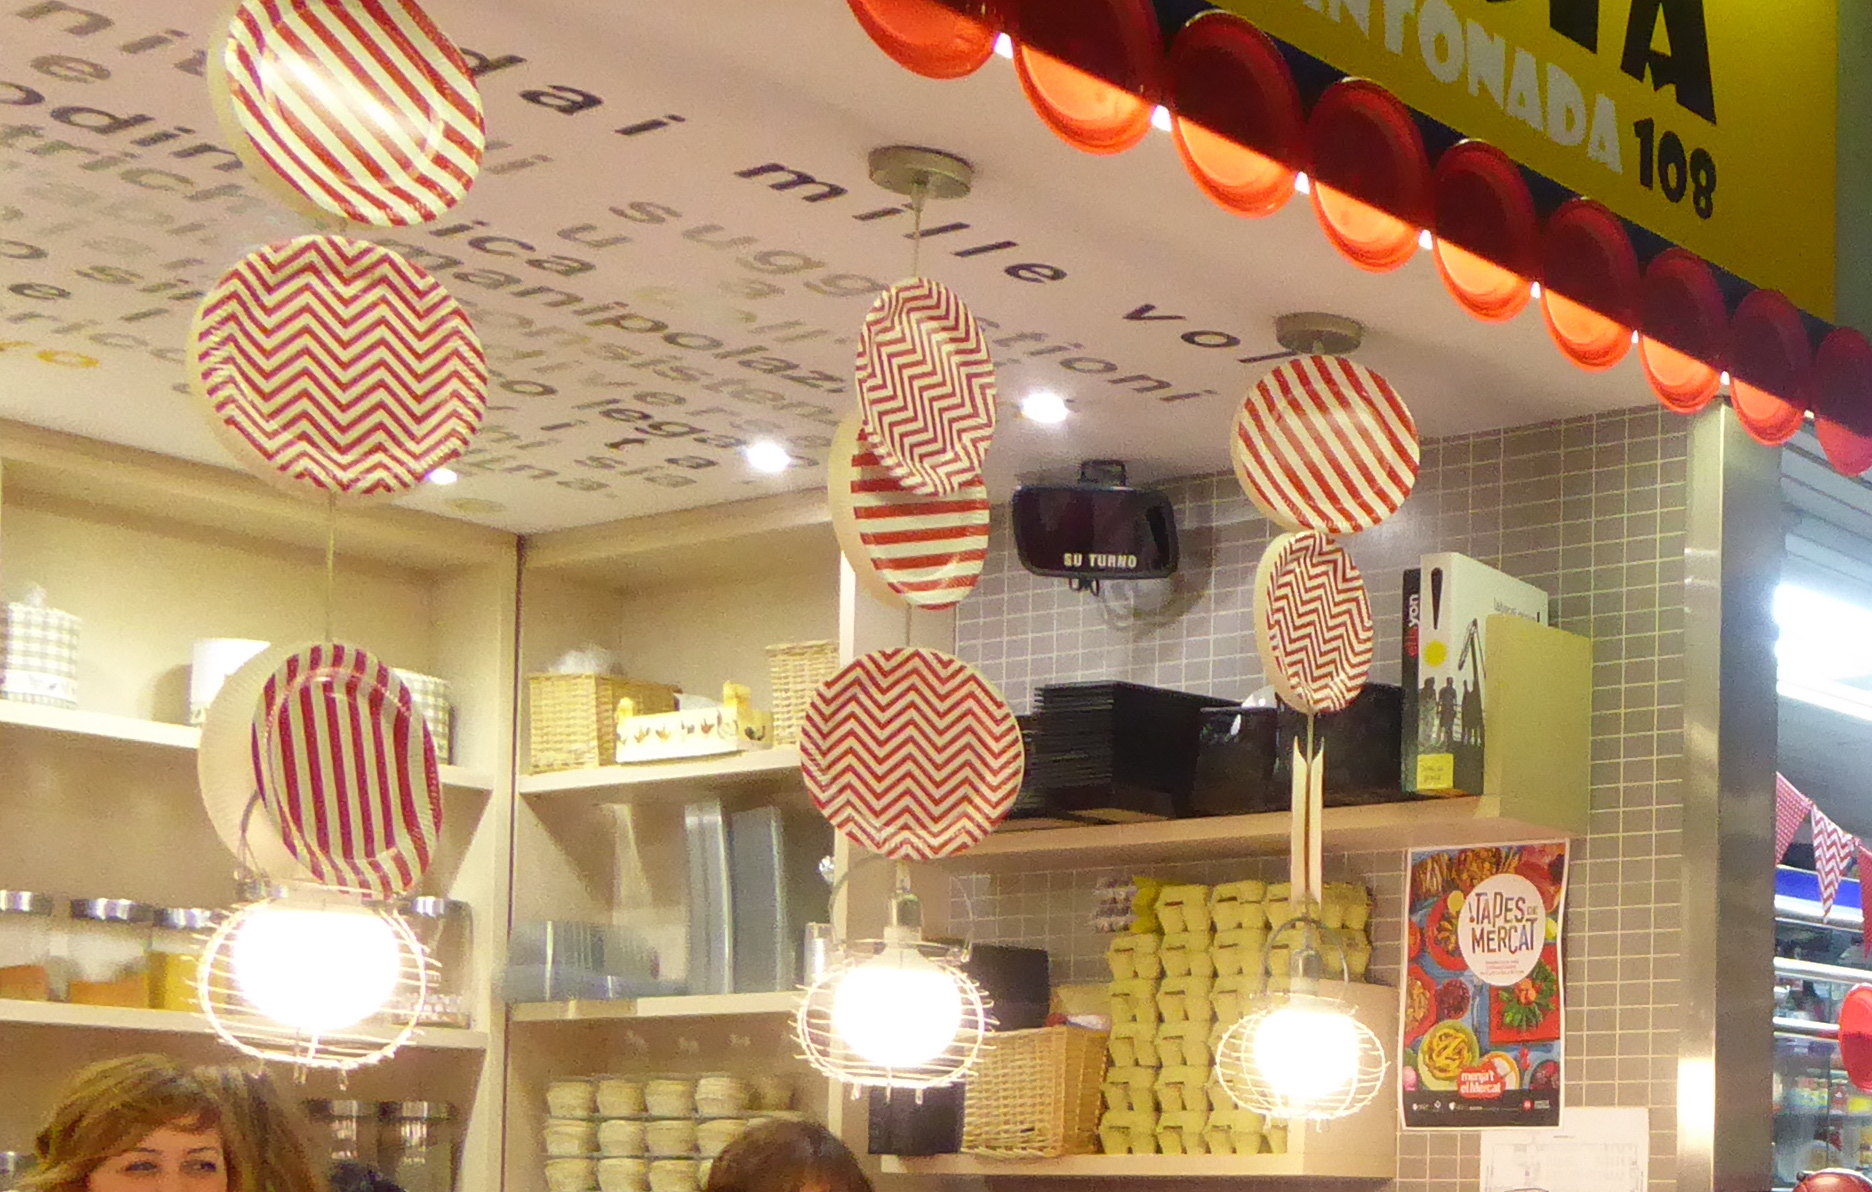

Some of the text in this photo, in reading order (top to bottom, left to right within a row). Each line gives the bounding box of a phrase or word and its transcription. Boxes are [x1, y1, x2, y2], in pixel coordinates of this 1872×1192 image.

[1634, 117, 1717, 219] 108
[733, 162, 1068, 285] mille
[1063, 552, 1138, 569] SU TURNO
[1475, 891, 1526, 928] TAPES
[1471, 917, 1538, 955] MERCAT
